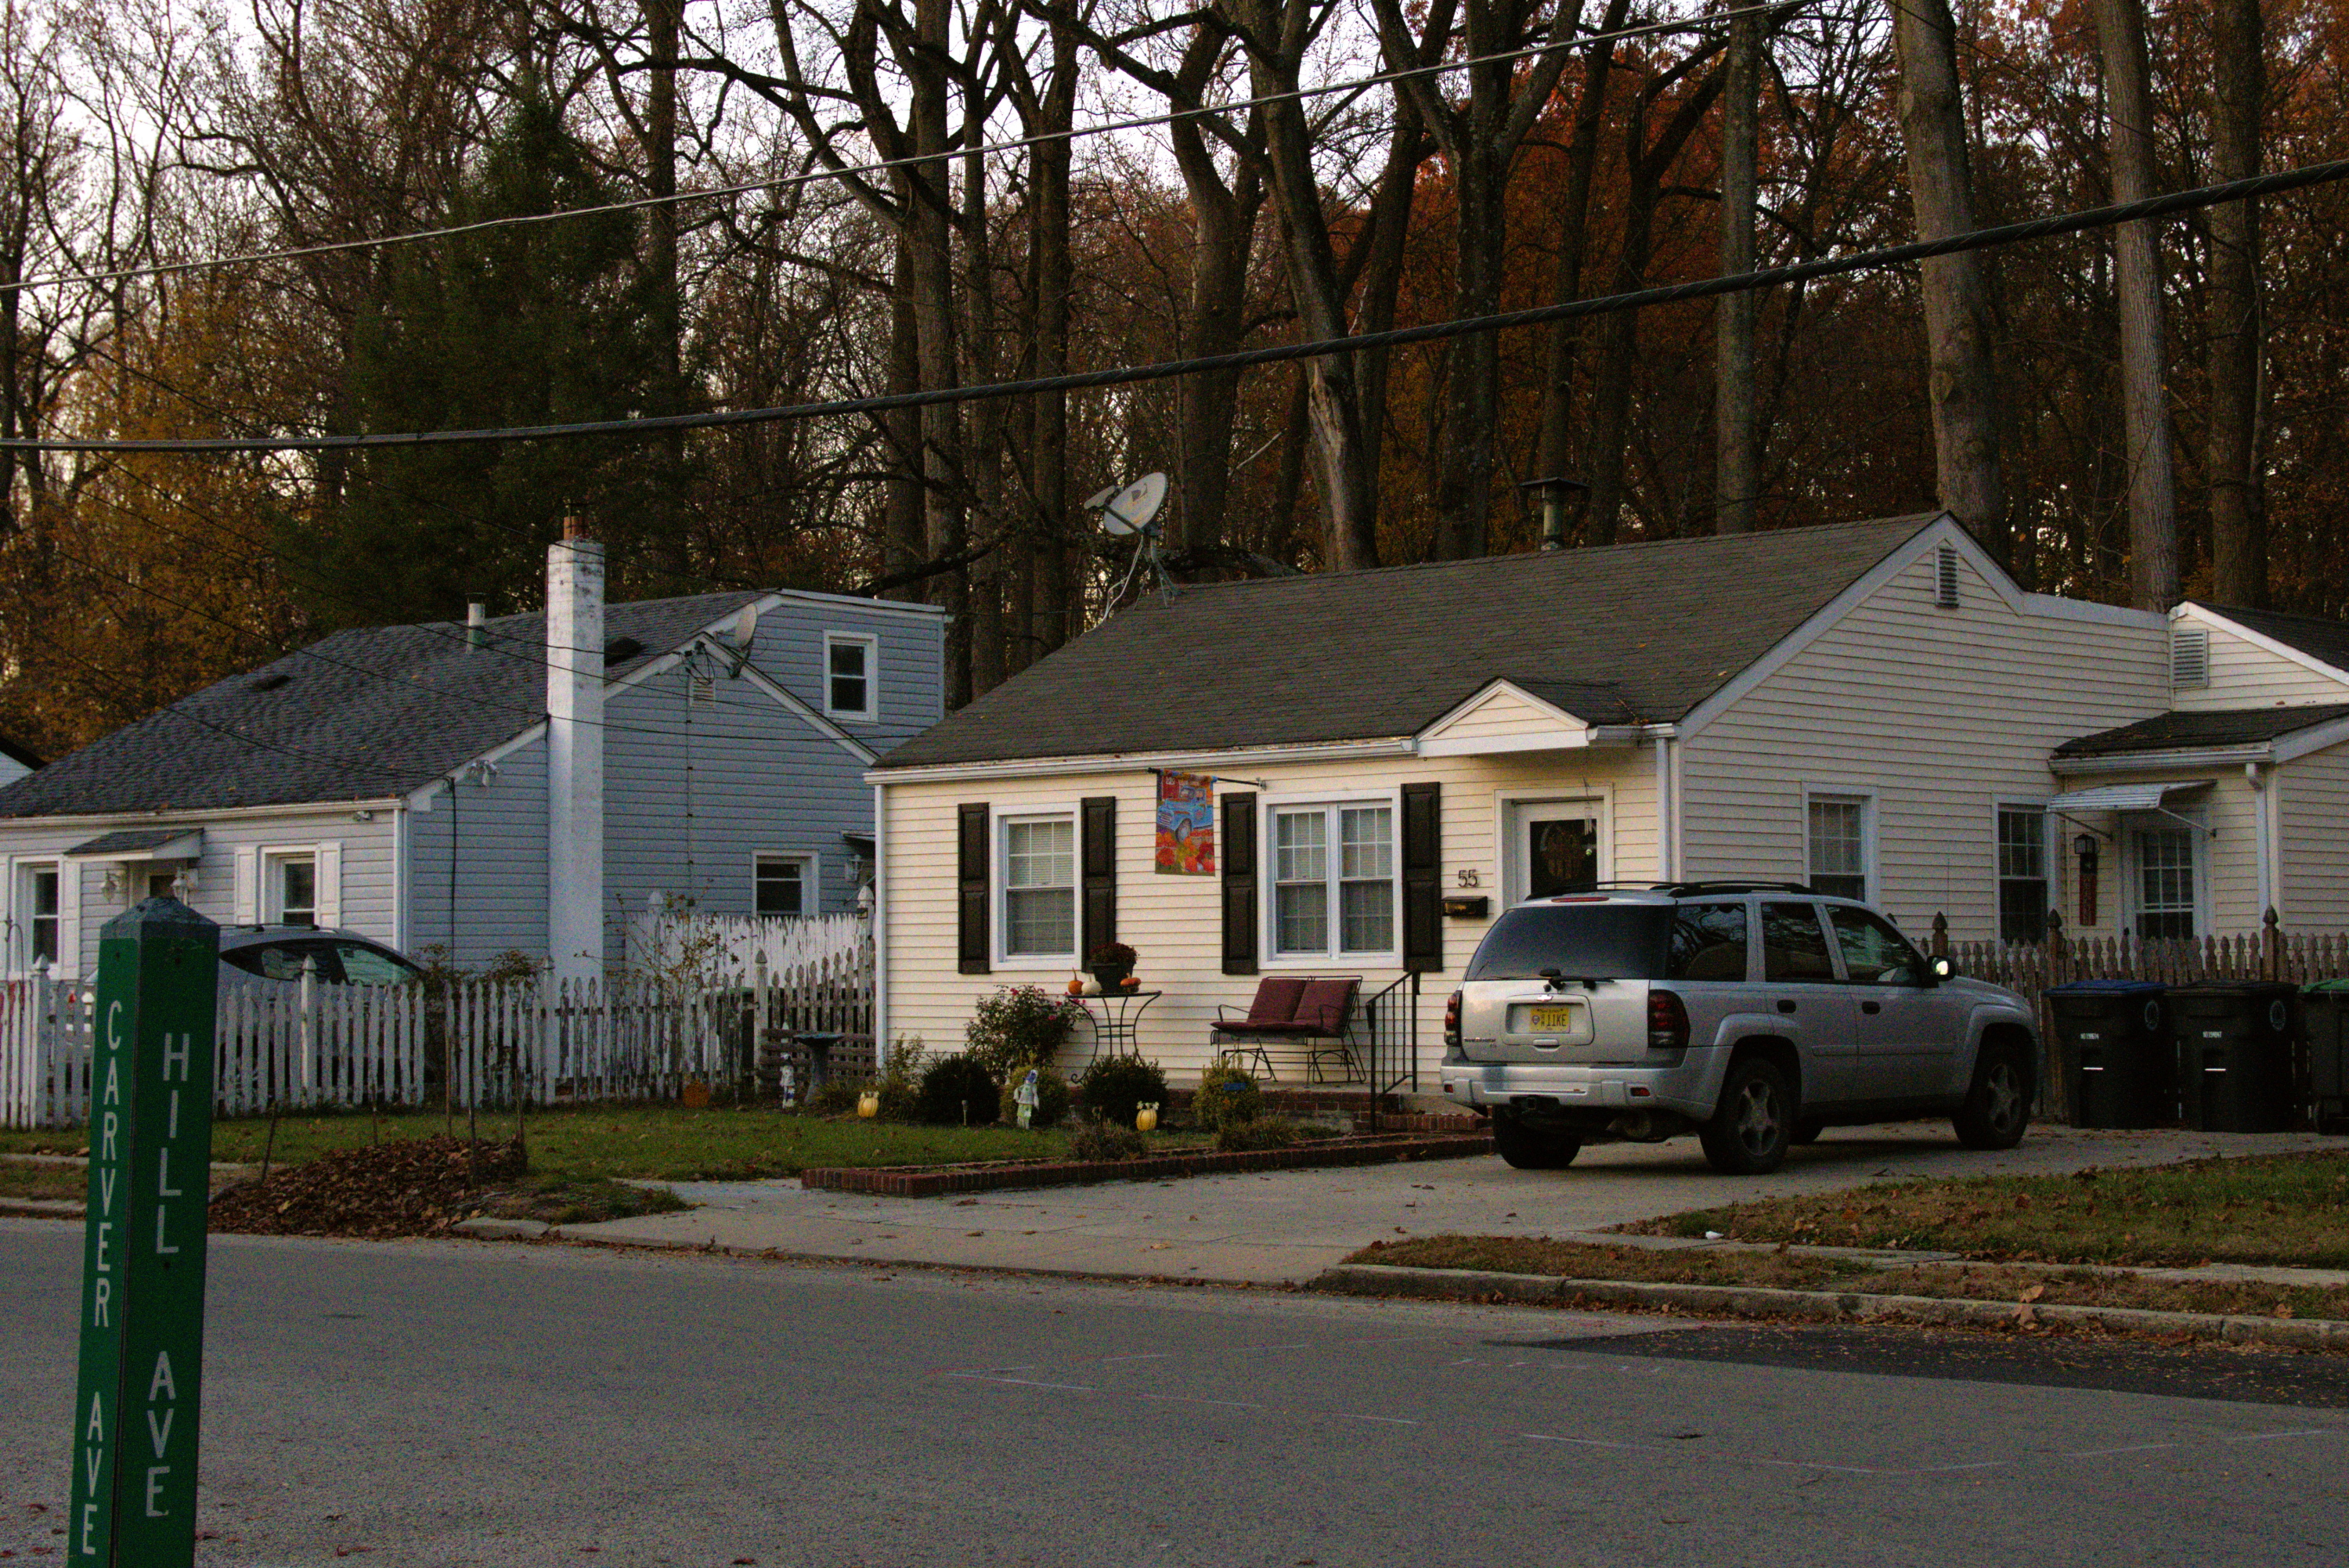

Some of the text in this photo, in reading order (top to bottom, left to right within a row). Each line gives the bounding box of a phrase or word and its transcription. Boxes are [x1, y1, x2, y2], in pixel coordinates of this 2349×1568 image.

[1458, 869, 1478, 888] 55
[82, 1000, 122, 1555] CARVER AVE
[146, 1032, 190, 1517] HILL AVE
